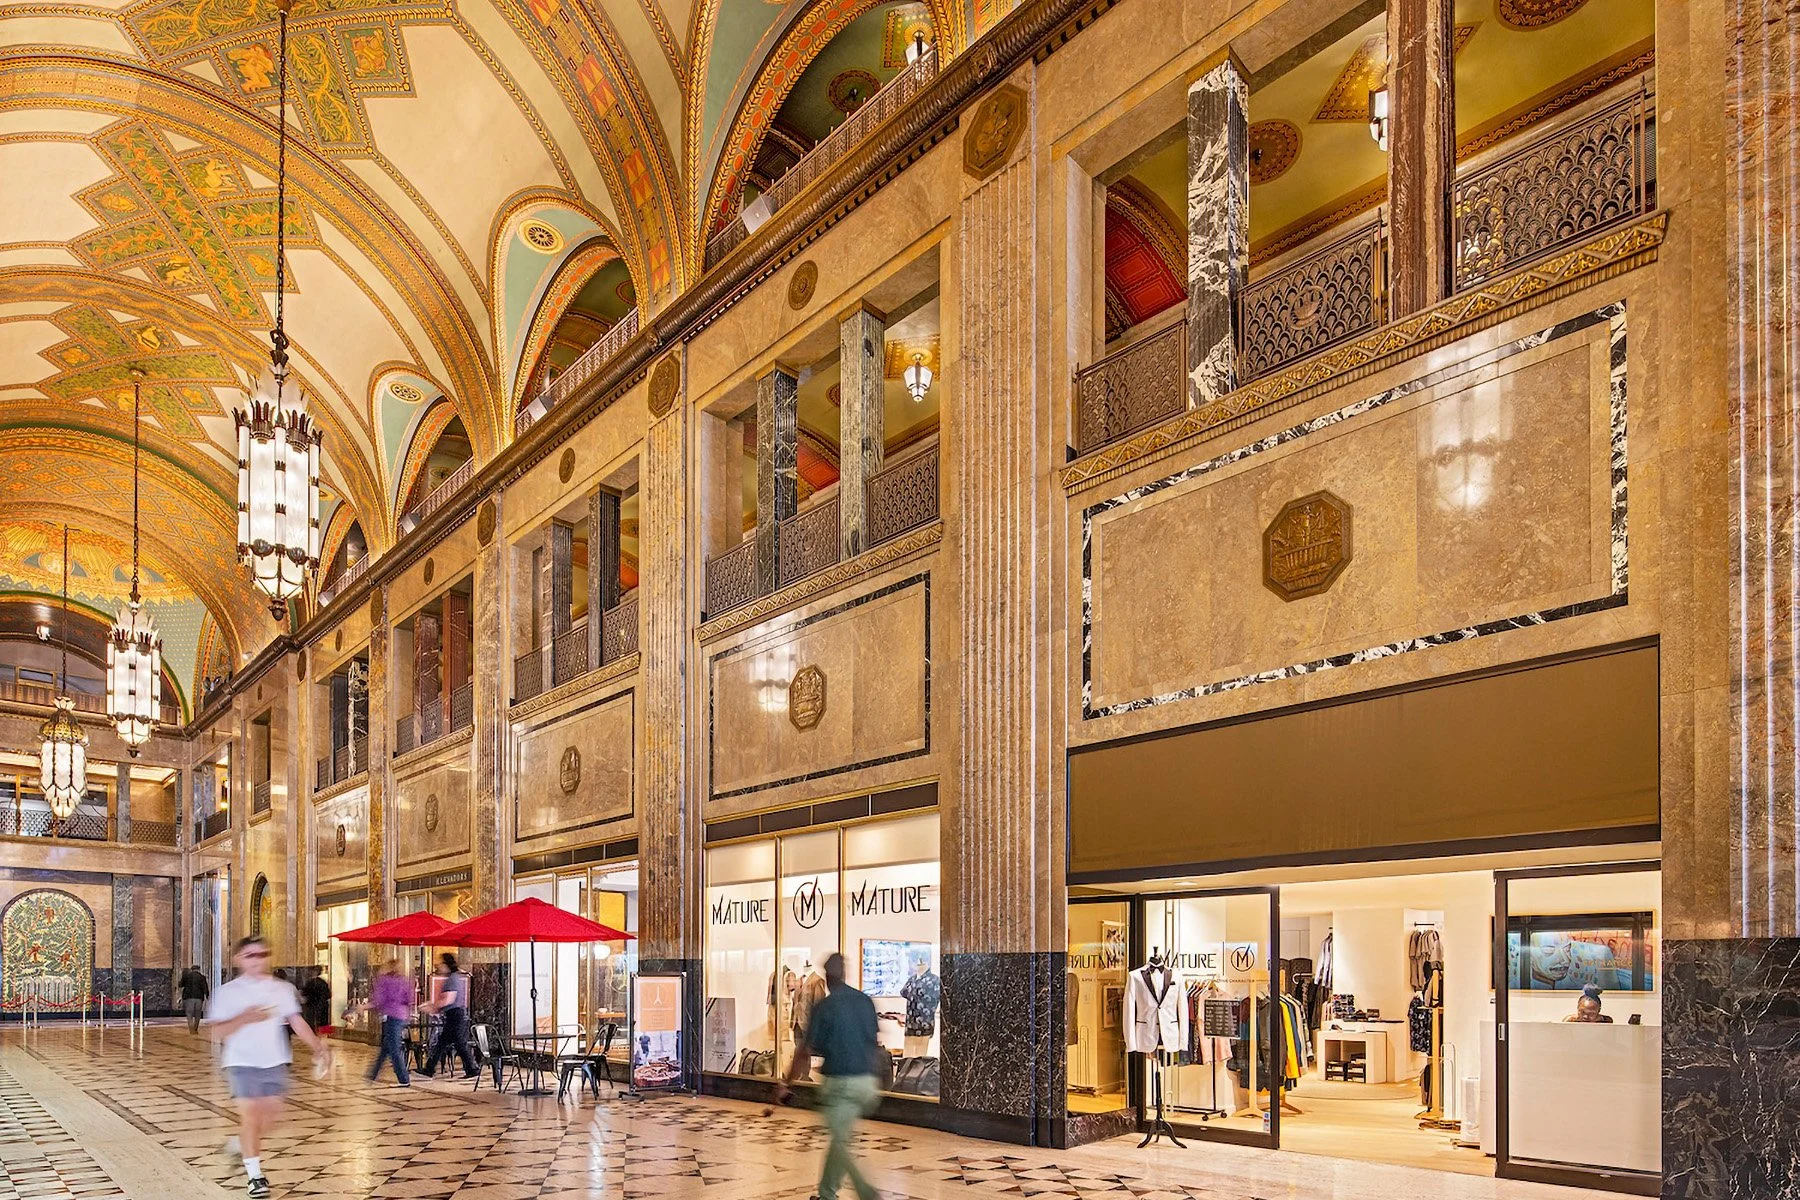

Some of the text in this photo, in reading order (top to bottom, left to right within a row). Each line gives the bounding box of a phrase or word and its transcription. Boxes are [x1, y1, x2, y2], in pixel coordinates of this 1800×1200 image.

[712, 893, 769, 925] MATURE
[851, 879, 931, 916] MATURE
[1160, 949, 1217, 969] MATURE
